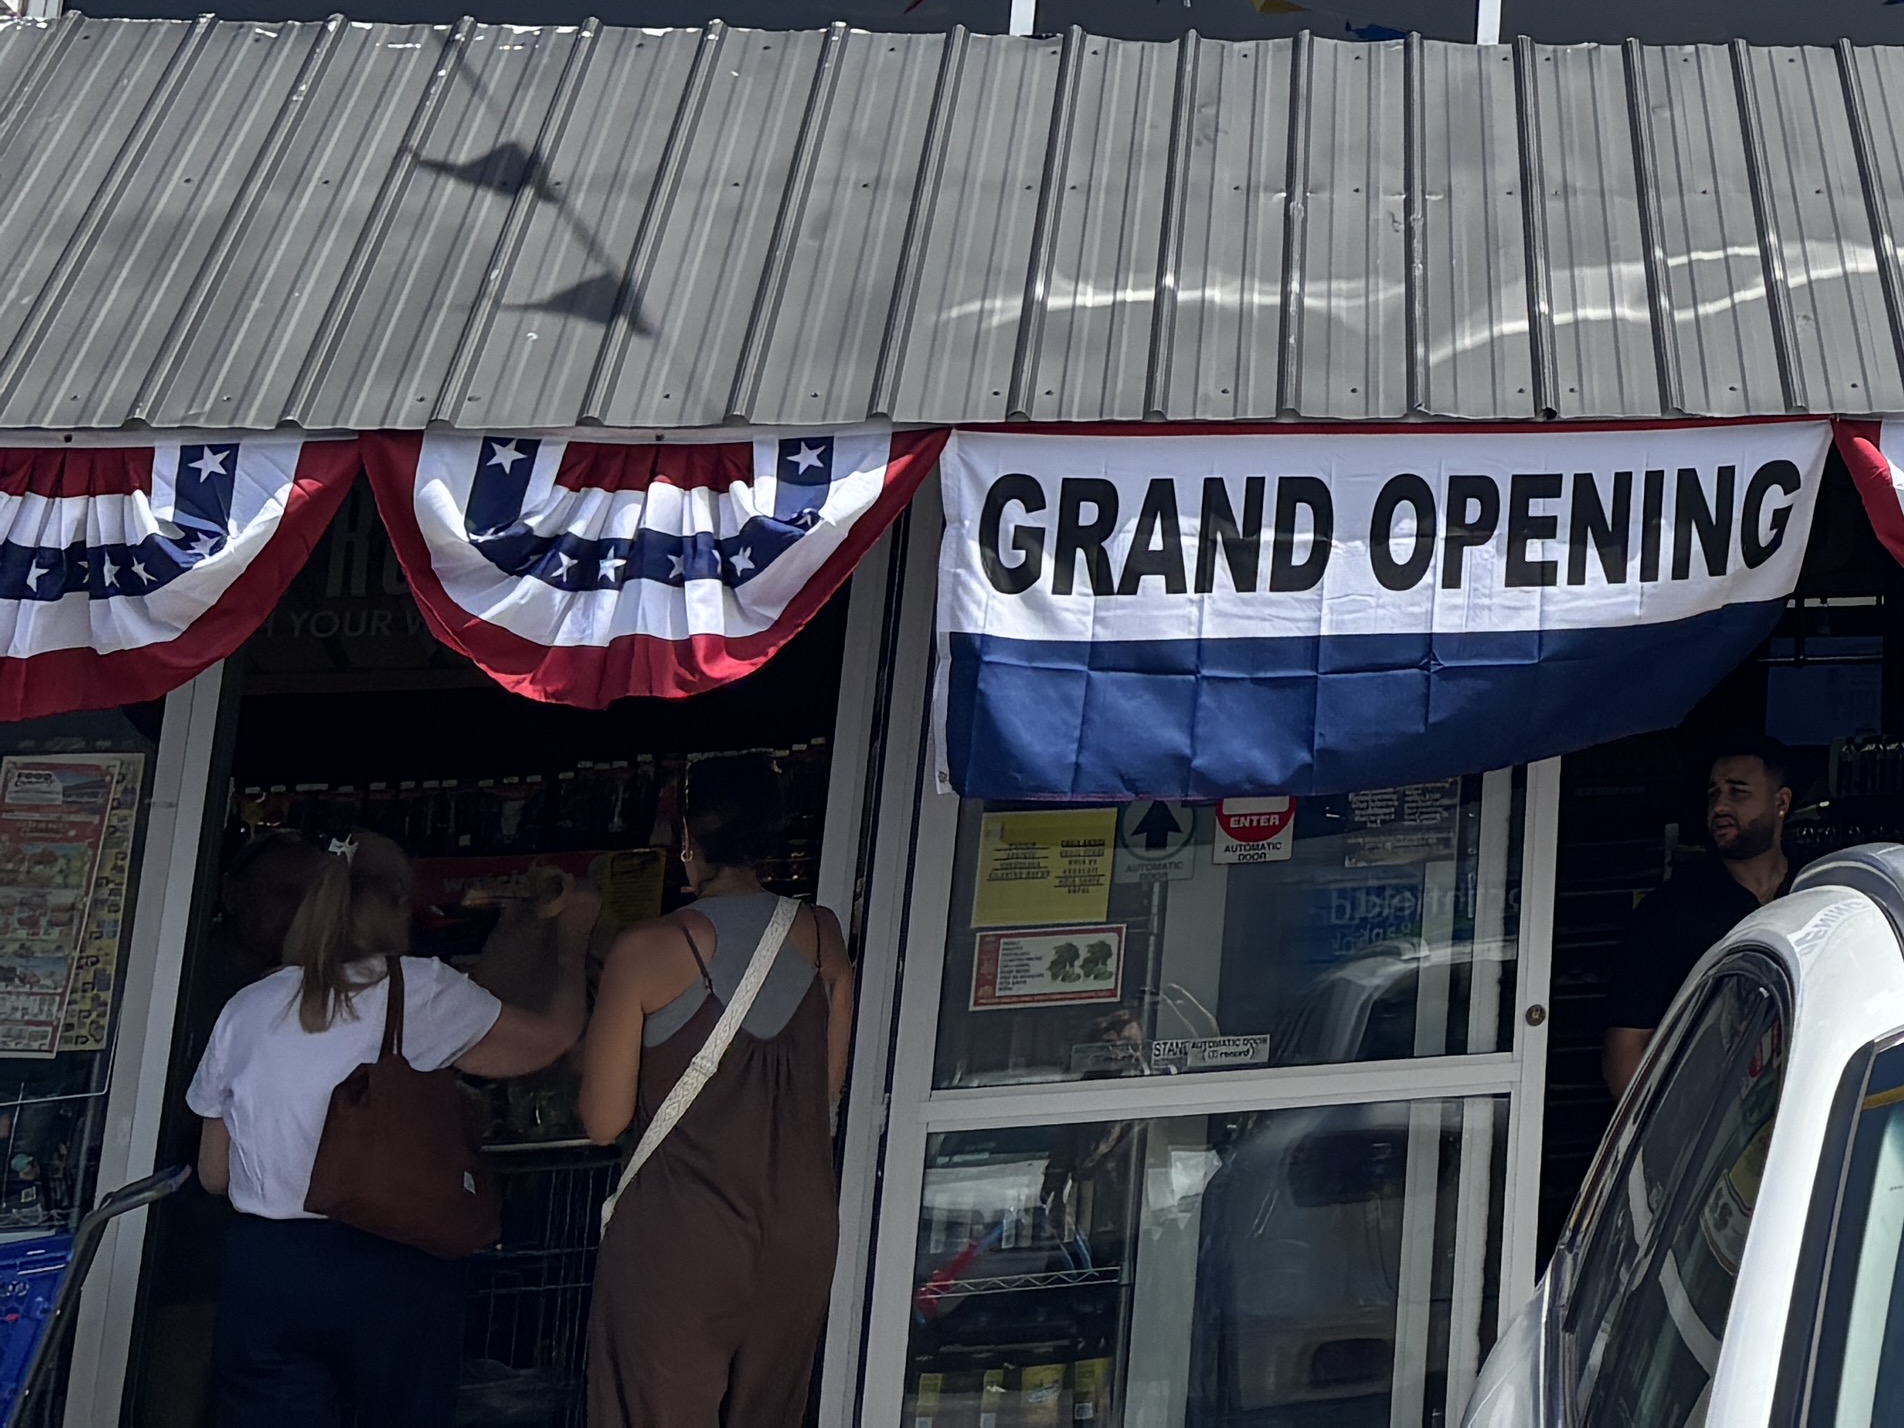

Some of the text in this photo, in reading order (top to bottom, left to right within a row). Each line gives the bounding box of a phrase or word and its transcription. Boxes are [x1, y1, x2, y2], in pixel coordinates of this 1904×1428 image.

[978, 459, 1802, 596] GRAND OPENING
[1229, 814, 1281, 829] ENTER
[1223, 841, 1283, 855] AUTOMATIC
[1237, 852, 1267, 862] DOOR
[1125, 861, 1184, 874] AUTOMATIC
